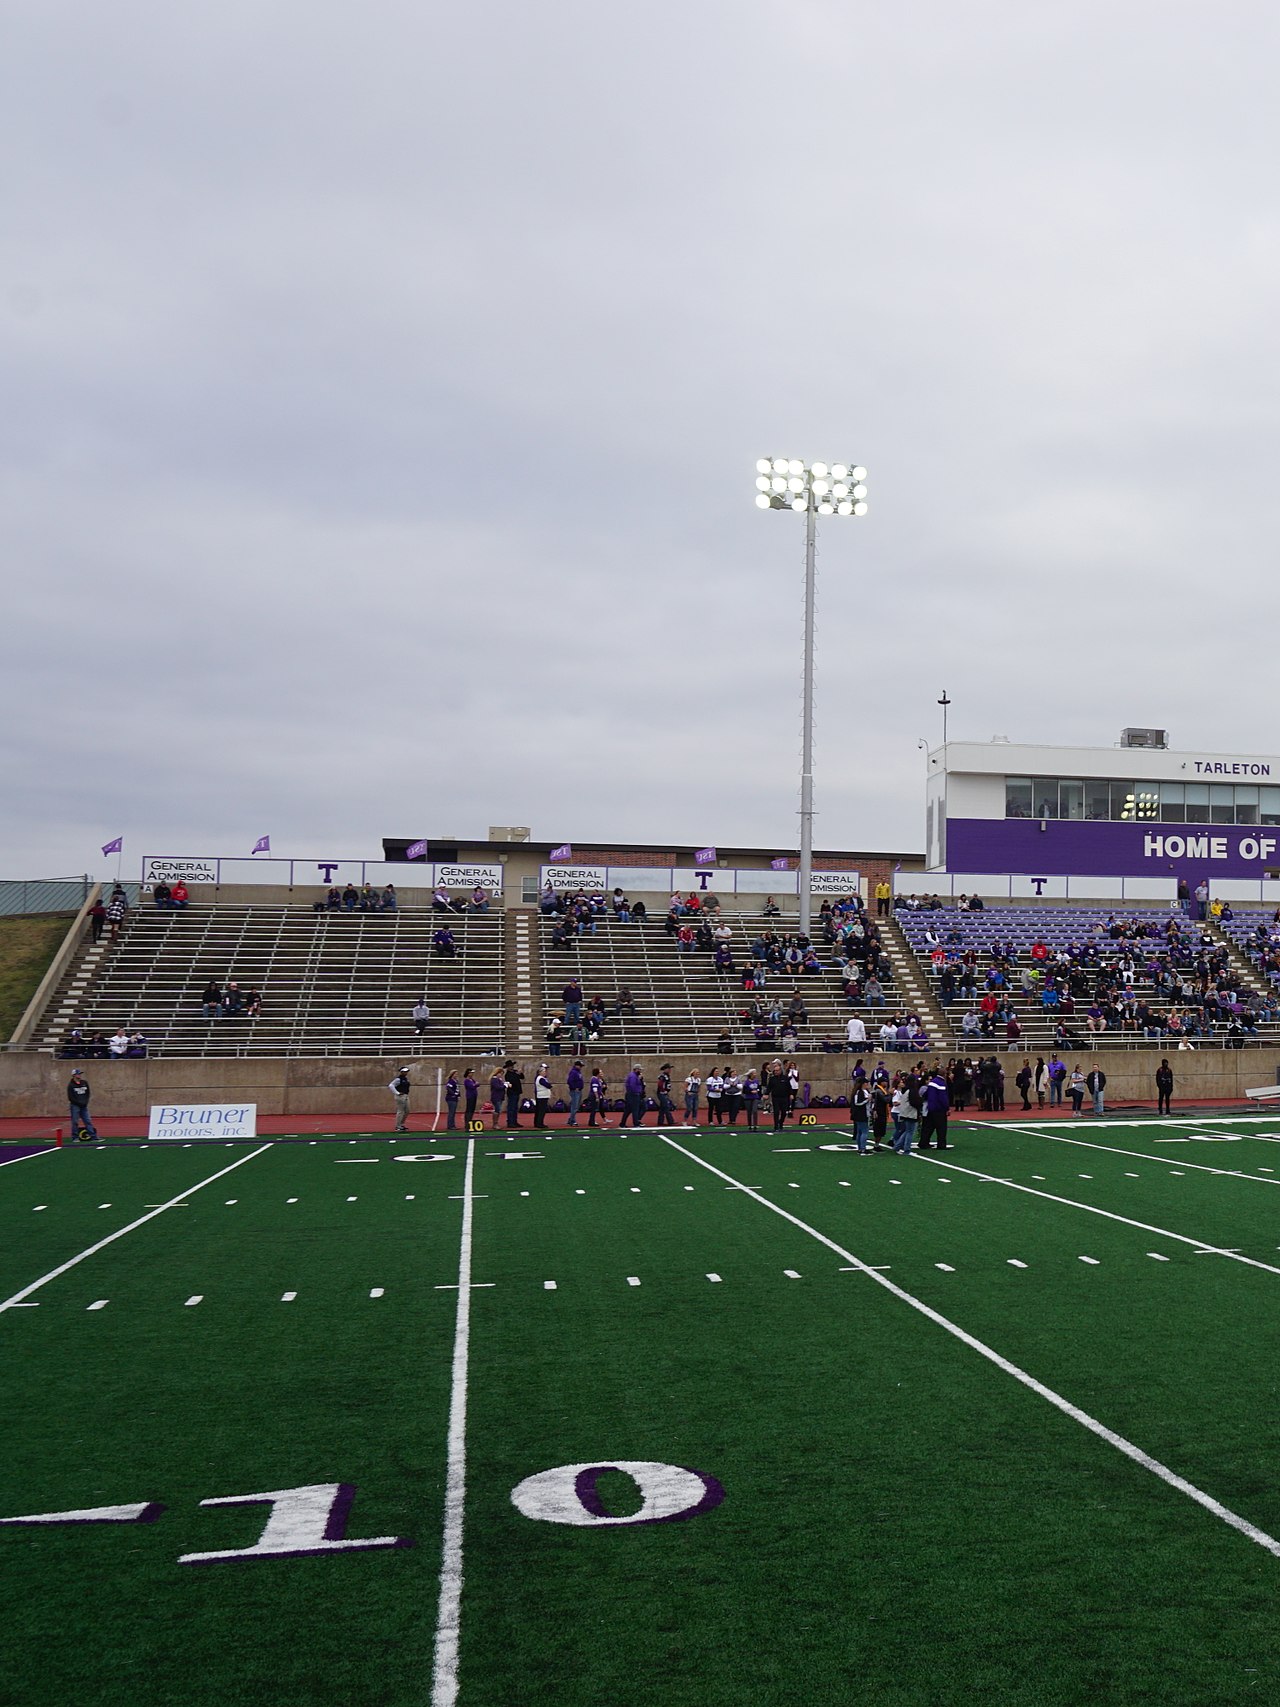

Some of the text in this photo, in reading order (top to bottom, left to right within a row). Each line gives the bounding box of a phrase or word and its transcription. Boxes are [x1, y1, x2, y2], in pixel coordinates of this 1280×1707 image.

[1194, 762, 1270, 776] TARLETON
[1144, 835, 1228, 858] HOME
[1239, 838, 1276, 860] OF
[150, 860, 212, 871] GENERAL
[147, 871, 215, 881] ADMISSION
[317, 864, 338, 883] T
[440, 866, 496, 877] GENERAL
[547, 868, 601, 878] GENERAL
[437, 876, 500, 887] ADMISSION
[544, 878, 605, 888] ADMISSION
[695, 871, 713, 890] T
[145, 885, 152, 893] A
[810, 884, 857, 892] DMISSION
[1031, 878, 1047, 895] T
[156, 1107, 250, 1125] Bruner
[801, 1115, 817, 1125] 20
[222, 1125, 247, 1136] inc.
[468, 1120, 483, 1132] 10
